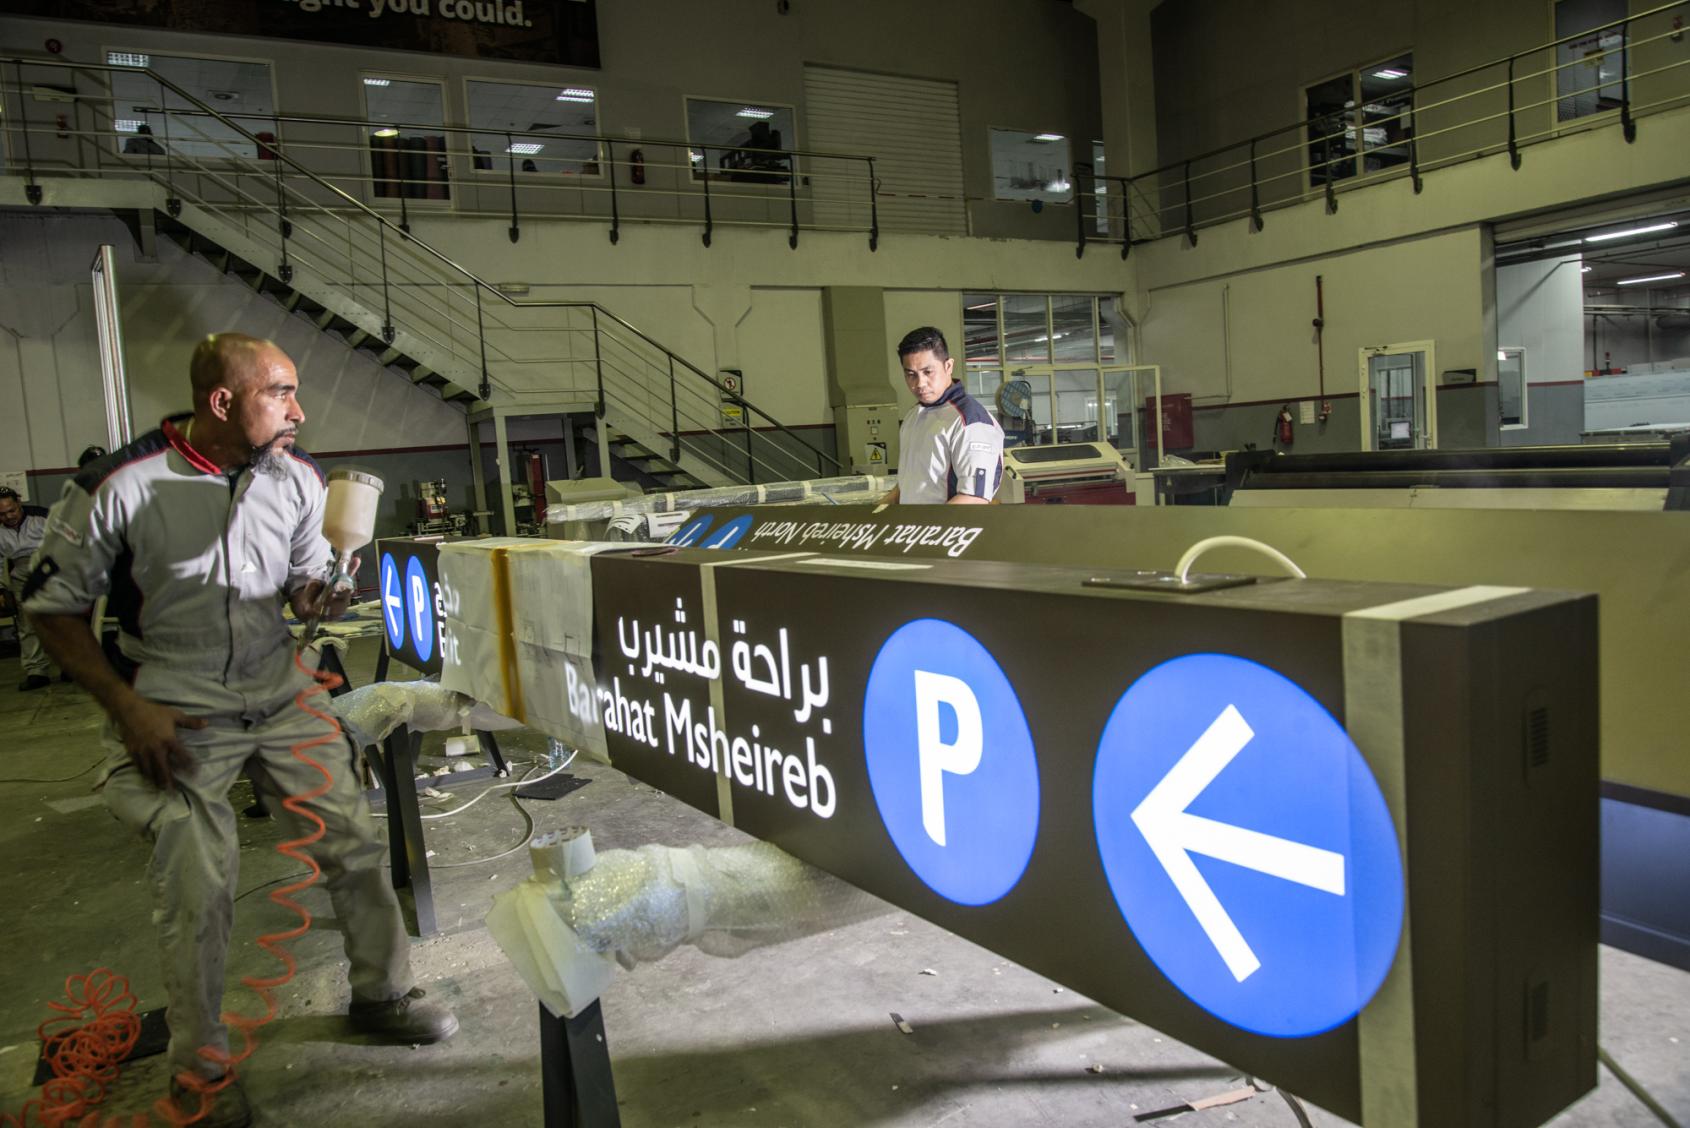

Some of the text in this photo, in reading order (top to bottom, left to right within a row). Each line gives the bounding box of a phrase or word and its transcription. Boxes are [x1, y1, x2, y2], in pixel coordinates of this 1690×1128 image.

[439, 0, 533, 28] could.
[751, 521, 984, 557] Barahat Msheireb North
[411, 575, 426, 641] P
[618, 597, 832, 734] براحة مشيرب
[564, 660, 837, 819] Barahat Msheireb
[914, 669, 984, 847] P
